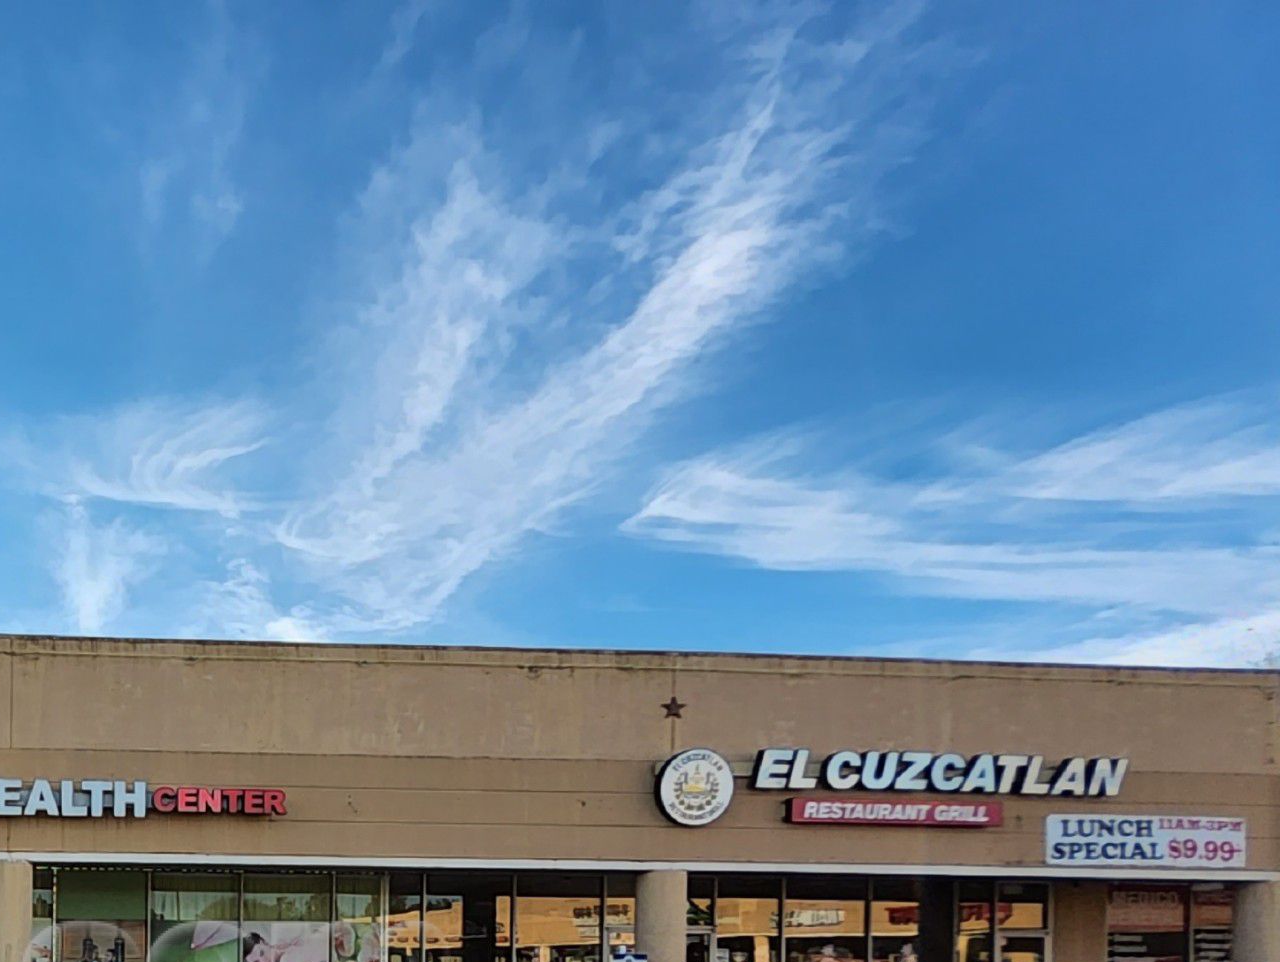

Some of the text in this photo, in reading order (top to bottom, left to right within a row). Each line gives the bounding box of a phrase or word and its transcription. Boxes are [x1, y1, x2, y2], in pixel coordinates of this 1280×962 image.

[754, 748, 1128, 797] EL CUZCATLAN
[153, 786, 287, 816] CENTER
[803, 801, 990, 822] RESTAURANT GRILL
[1061, 819, 1153, 838] LUNCH
[1051, 842, 1163, 860] SPECIAL
